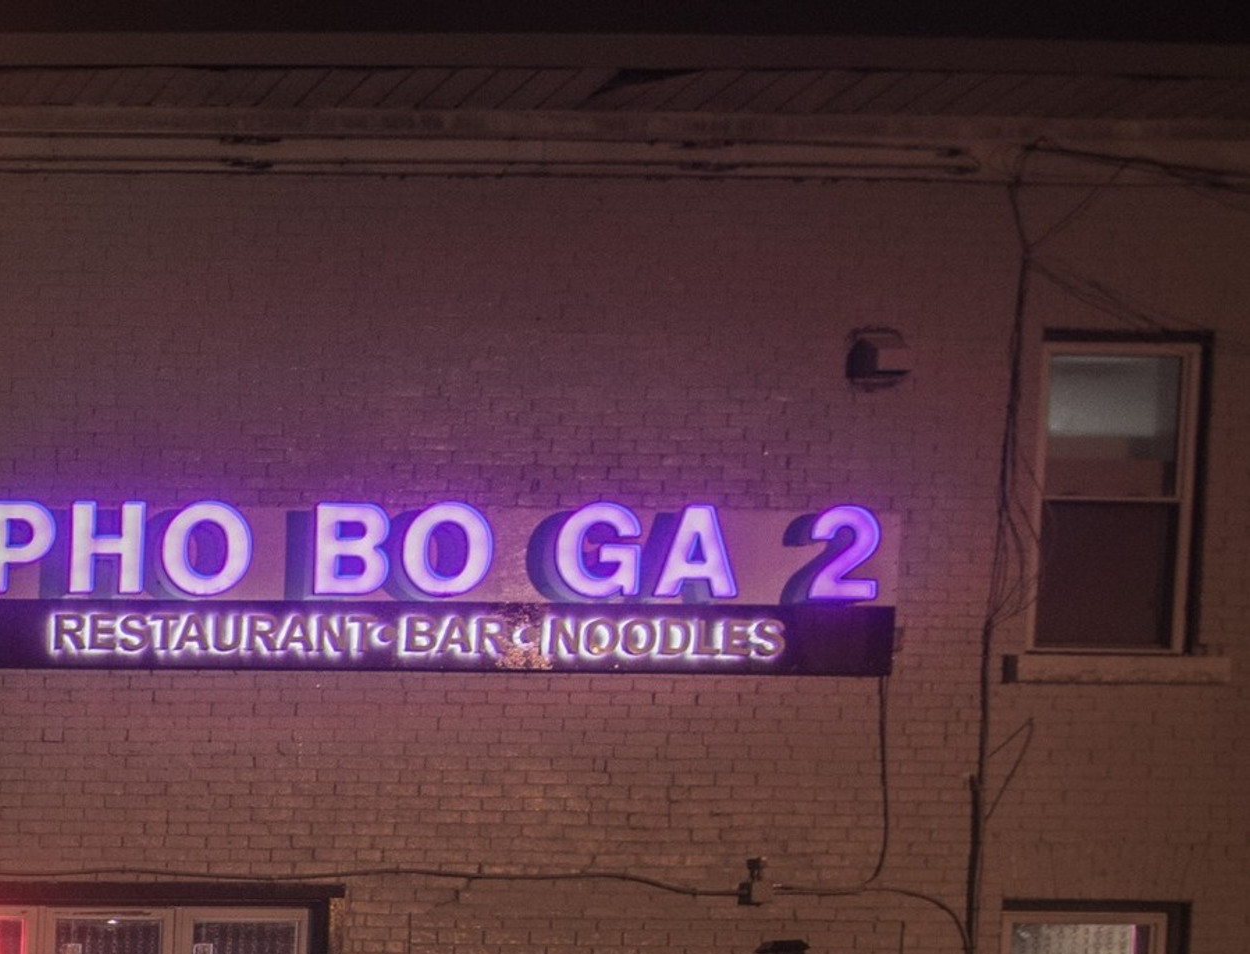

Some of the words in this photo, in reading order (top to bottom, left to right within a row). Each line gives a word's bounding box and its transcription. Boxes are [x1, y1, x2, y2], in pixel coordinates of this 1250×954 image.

[314, 500, 493, 596] BO
[555, 501, 738, 599] GA
[808, 504, 881, 600] 2
[49, 611, 374, 657] RESTAURANT
[399, 614, 502, 658] BAR
[542, 615, 786, 661] NOODLES
